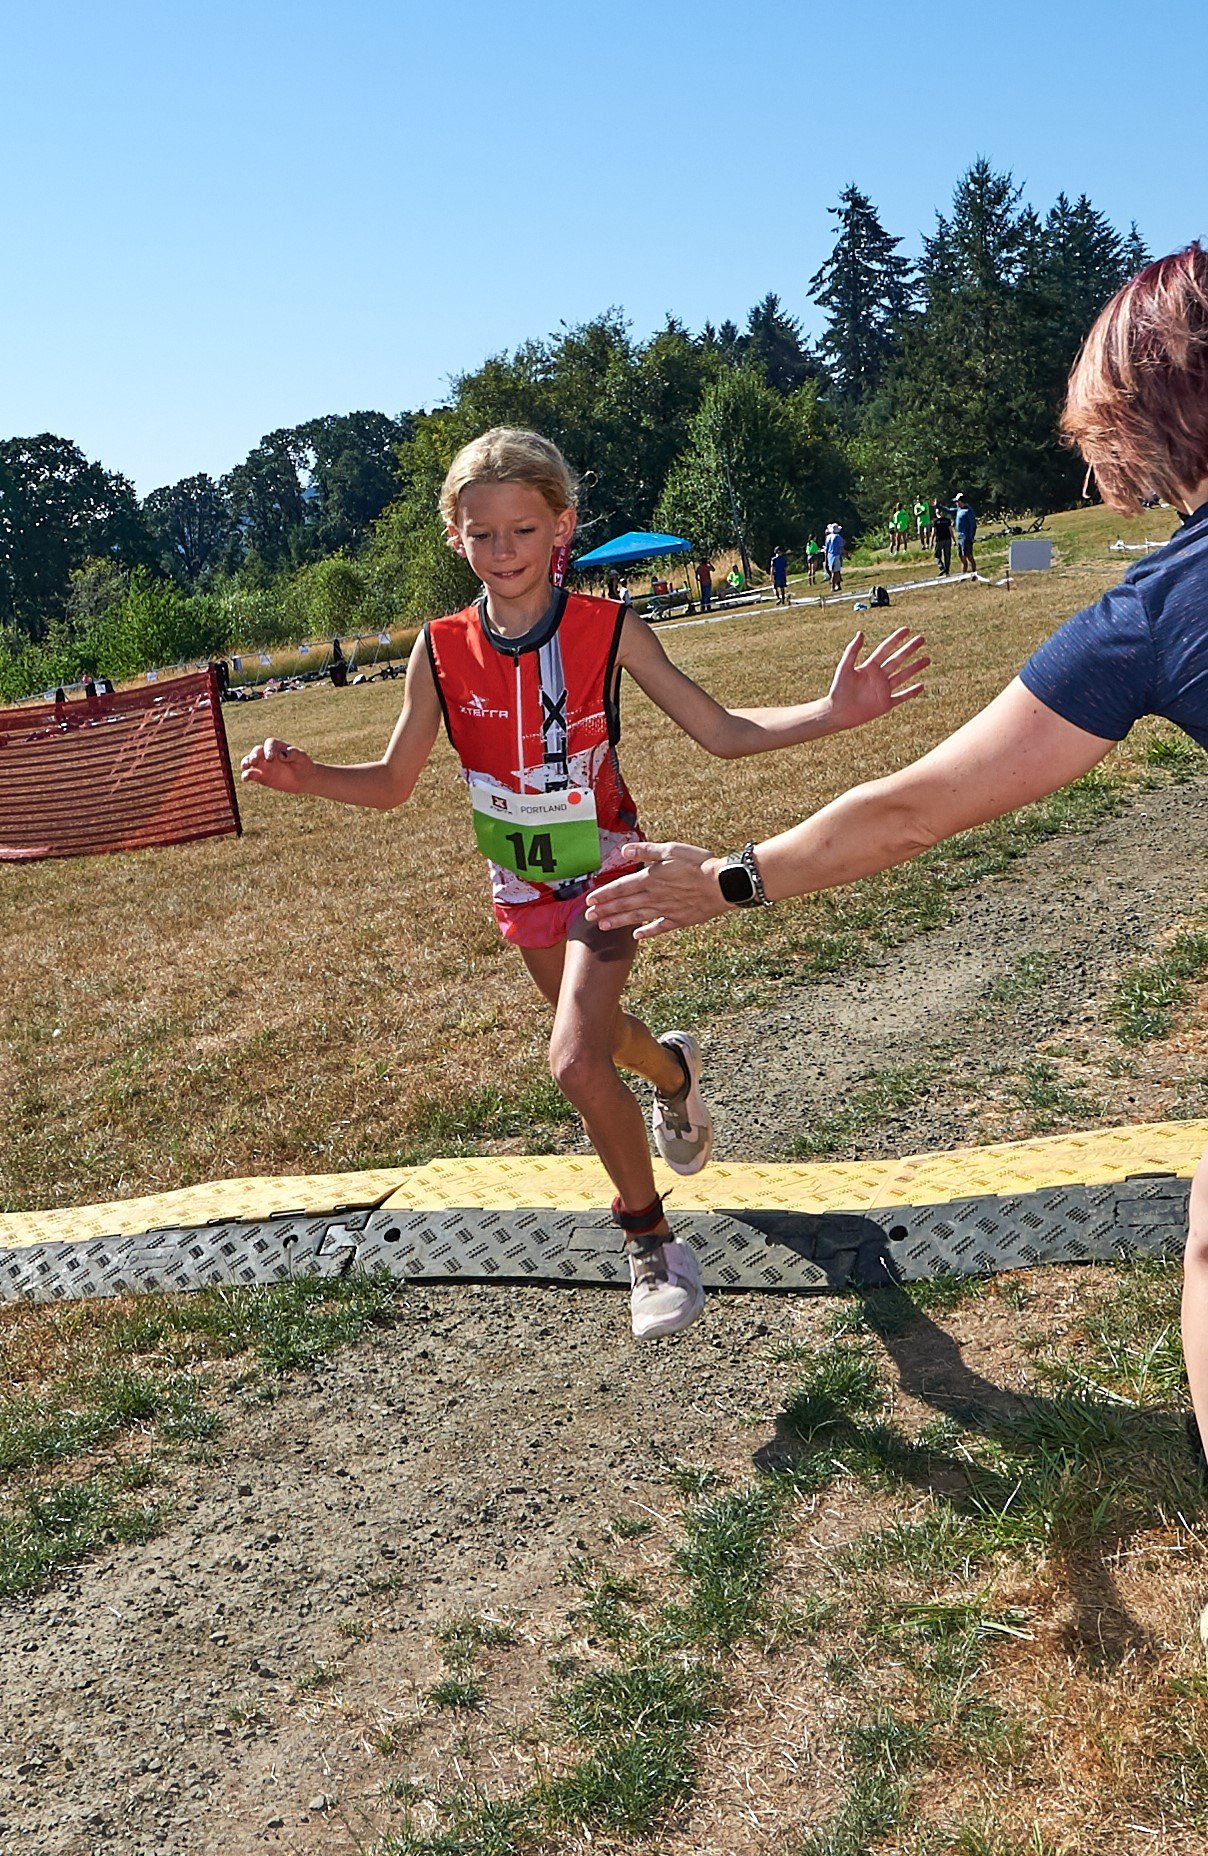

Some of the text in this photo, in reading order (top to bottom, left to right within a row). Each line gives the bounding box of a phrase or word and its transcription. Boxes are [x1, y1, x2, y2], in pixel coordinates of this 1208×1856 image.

[460, 705, 509, 719] XTERRA
[520, 803, 567, 814] PORTLAND
[505, 831, 558, 873] 14
